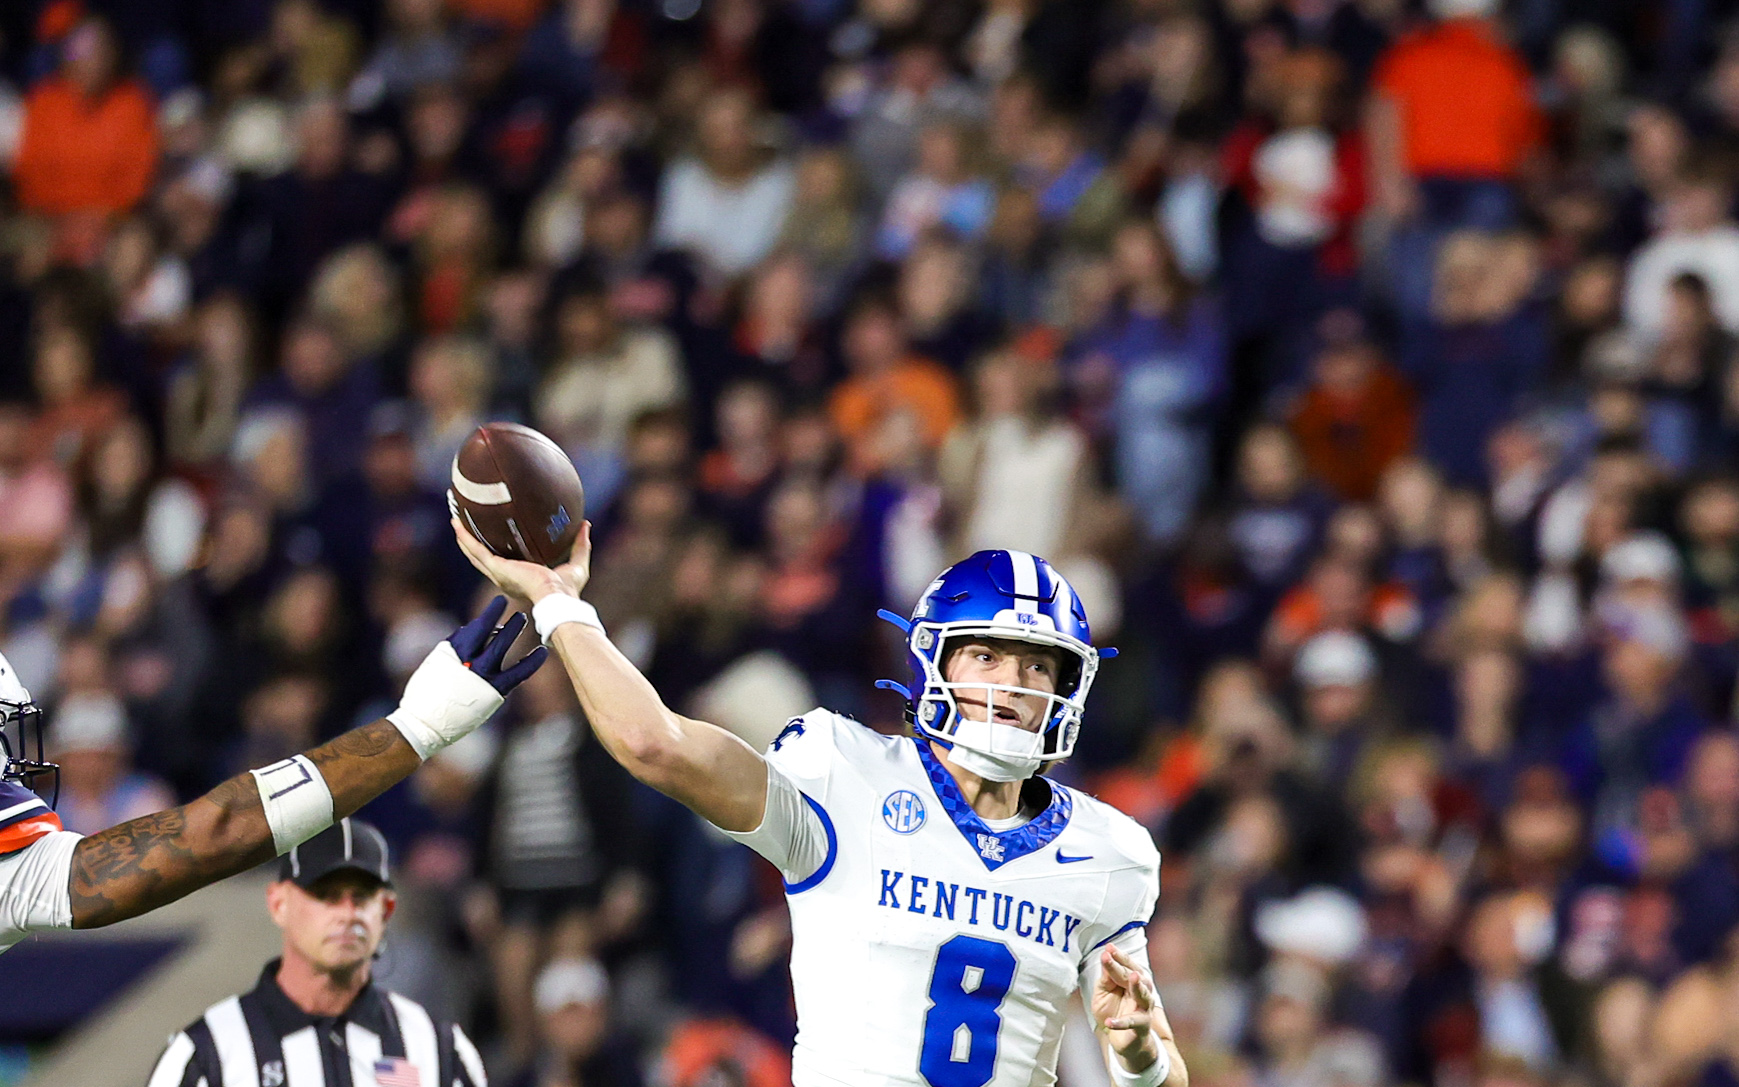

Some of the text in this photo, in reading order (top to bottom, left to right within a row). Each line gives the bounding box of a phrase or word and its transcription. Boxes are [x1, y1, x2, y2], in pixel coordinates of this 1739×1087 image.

[884, 791, 924, 832] SEC
[976, 833, 1005, 862] UK
[878, 869, 1081, 953] KENTUCKY
